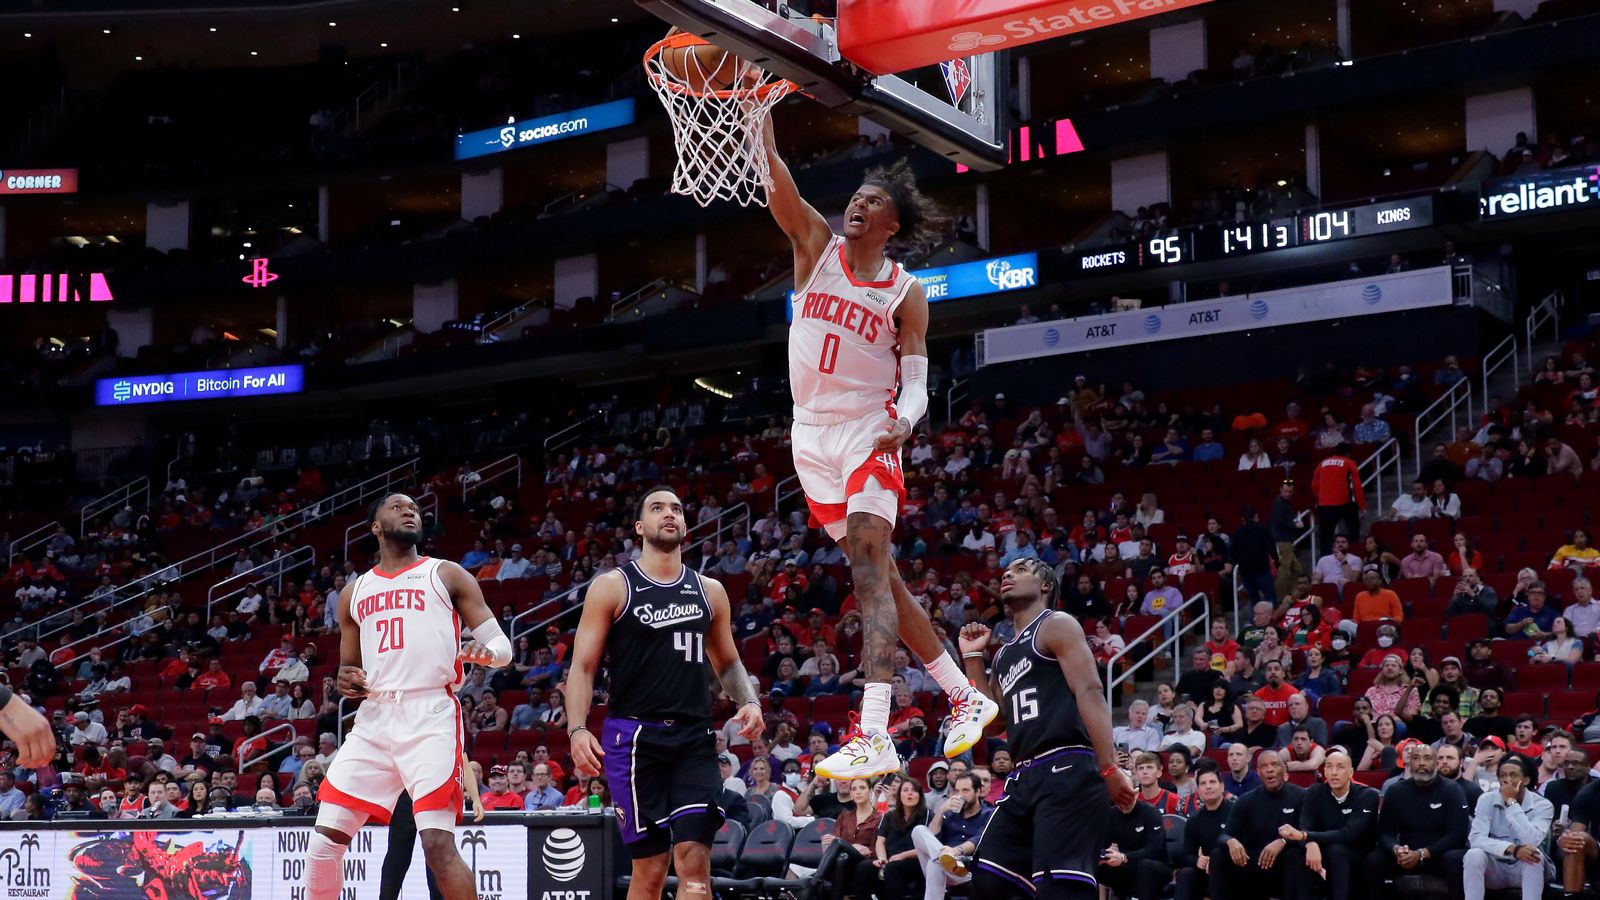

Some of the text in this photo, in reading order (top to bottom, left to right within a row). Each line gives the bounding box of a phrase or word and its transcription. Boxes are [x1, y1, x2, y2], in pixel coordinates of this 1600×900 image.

[7, 175, 61, 189] CORNER
[1488, 177, 1590, 215] reliant
[1309, 211, 1349, 240] 104
[1377, 208, 1411, 224] KINGS
[1082, 251, 1126, 269] ROCKETS
[1150, 236, 1181, 263] 95
[998, 267, 1035, 290] KBR
[801, 292, 884, 344] ROCKETS
[1188, 309, 1222, 325] AT&T
[1086, 324, 1117, 338] AT&T
[818, 332, 840, 375] 0
[132, 373, 285, 396] NYDIG Bitcoin For All
[356, 588, 426, 624] ROCKETS
[633, 603, 703, 626] Sactown
[375, 616, 405, 654] 20
[673, 631, 704, 663] 41
[1011, 687, 1039, 725] 15
[278, 831, 310, 853] NOW
[357, 831, 372, 853] IN
[8, 888, 50, 898] RESTAURANT
